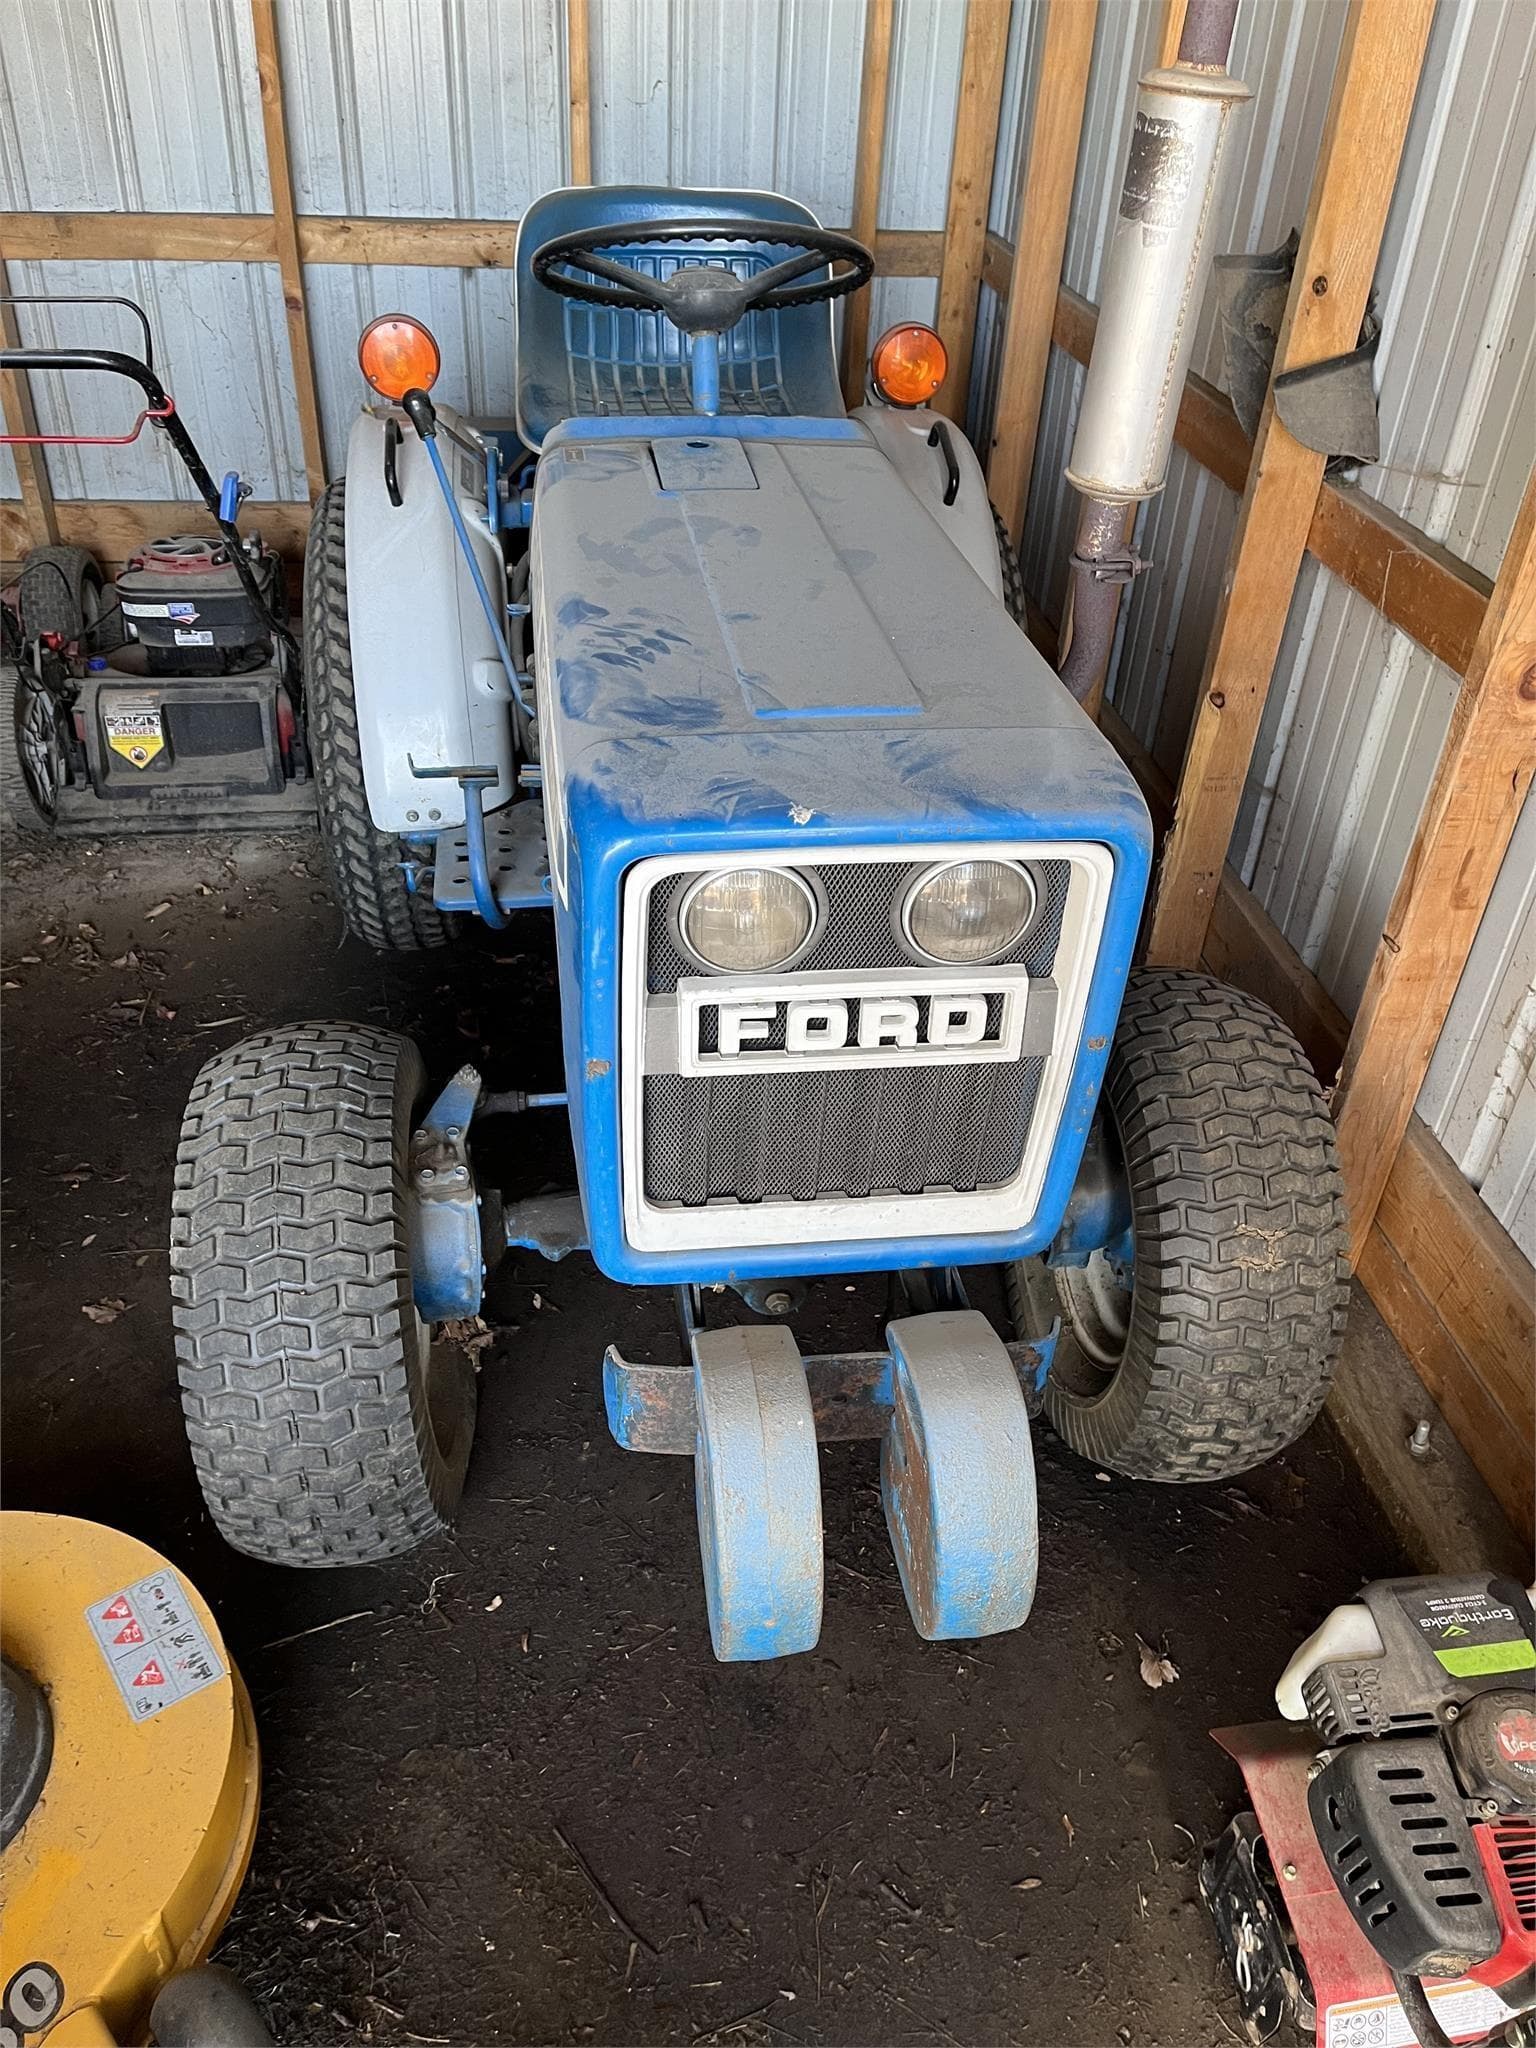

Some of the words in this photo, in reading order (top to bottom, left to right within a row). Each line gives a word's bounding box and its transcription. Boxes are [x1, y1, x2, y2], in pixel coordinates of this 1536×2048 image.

[114, 727, 156, 735] DANGER
[718, 994, 987, 1057] FORD
[1420, 1608, 1514, 1629] Earthquake
